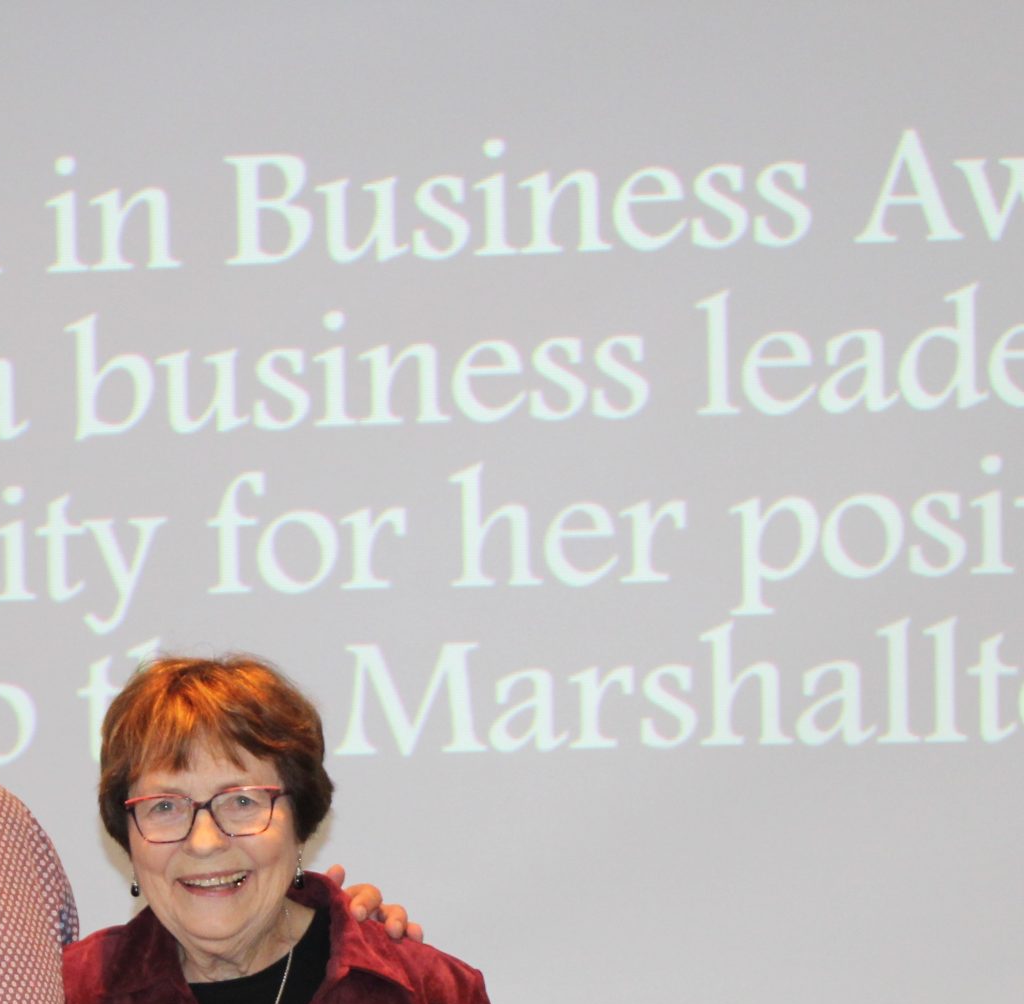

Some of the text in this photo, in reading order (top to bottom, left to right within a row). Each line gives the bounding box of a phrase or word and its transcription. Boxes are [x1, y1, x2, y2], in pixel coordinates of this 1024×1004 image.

[45, 155, 181, 274] in
[223, 138, 811, 266] Business
[63, 311, 649, 441] business
[206, 472, 406, 595] for
[448, 462, 686, 588] her
[728, 454, 1024, 615] posi
[334, 615, 1024, 757] Marshallt
